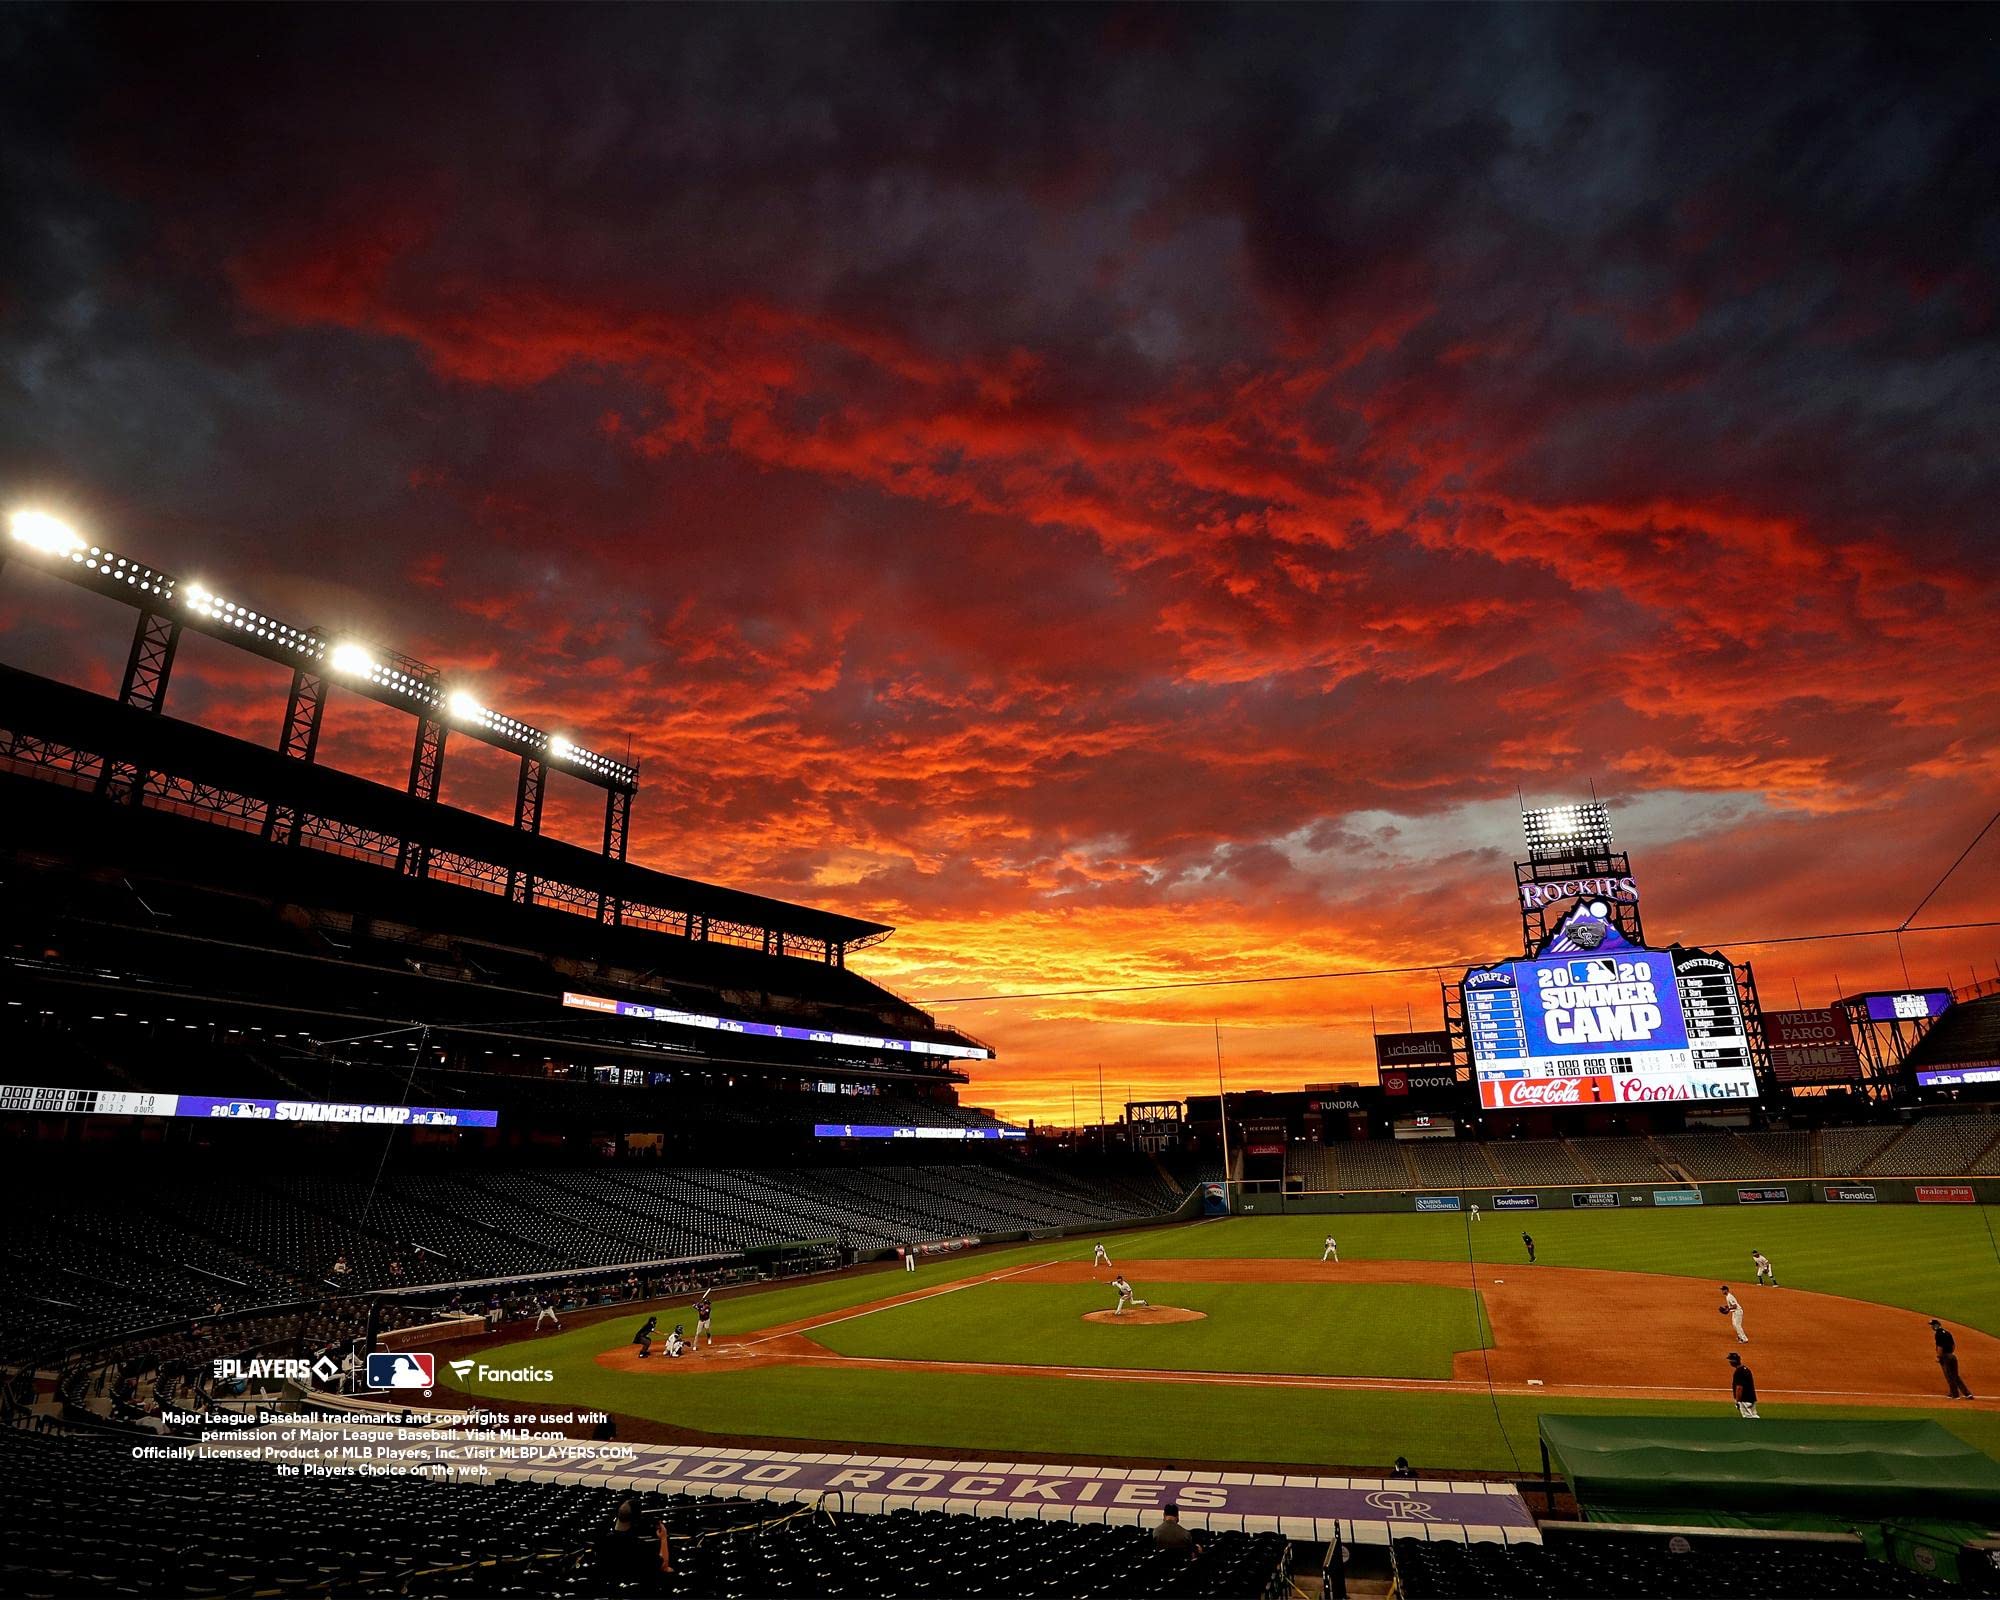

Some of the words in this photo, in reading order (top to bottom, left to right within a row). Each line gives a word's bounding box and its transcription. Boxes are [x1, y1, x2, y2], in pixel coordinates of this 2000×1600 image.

[1520, 876, 1639, 909] ROCKIES
[1677, 958, 1726, 973] PINSTRIPE
[1468, 972, 1512, 987] PURPLE
[1537, 967, 1570, 988] 20
[1618, 962, 1652, 984] 20
[1539, 981, 1659, 1011] SUMMER
[1543, 1001, 1662, 1045] CAMP
[1776, 1012, 1833, 1025] WELLS
[1781, 1026, 1836, 1040] FARGO
[1387, 1040, 1442, 1056] uchealth
[1785, 1049, 1842, 1065] KING
[1789, 1064, 1846, 1081] Soopers
[1408, 1076, 1455, 1088] TOYOTA
[1620, 1078, 1691, 1101] Coors
[1691, 1081, 1751, 1099] LIGHT
[1509, 1078, 1581, 1104] Coca-Cola
[139, 1095, 155, 1107] 1-0
[1320, 1100, 1360, 1110] TUNDRA
[211, 1105, 229, 1117] 20
[253, 1107, 270, 1118] 20
[275, 1102, 362, 1123] SUMMER
[361, 1106, 410, 1124] CAMP
[412, 1114, 425, 1124] 20
[444, 1115, 457, 1125] 20
[1839, 1191, 1875, 1200] Fanatics
[1920, 1187, 1949, 1196] brakes
[1951, 1187, 1969, 1196] plus
[1497, 1198, 1530, 1207] Southwest
[823, 1468, 1228, 1508] ROCKIES
